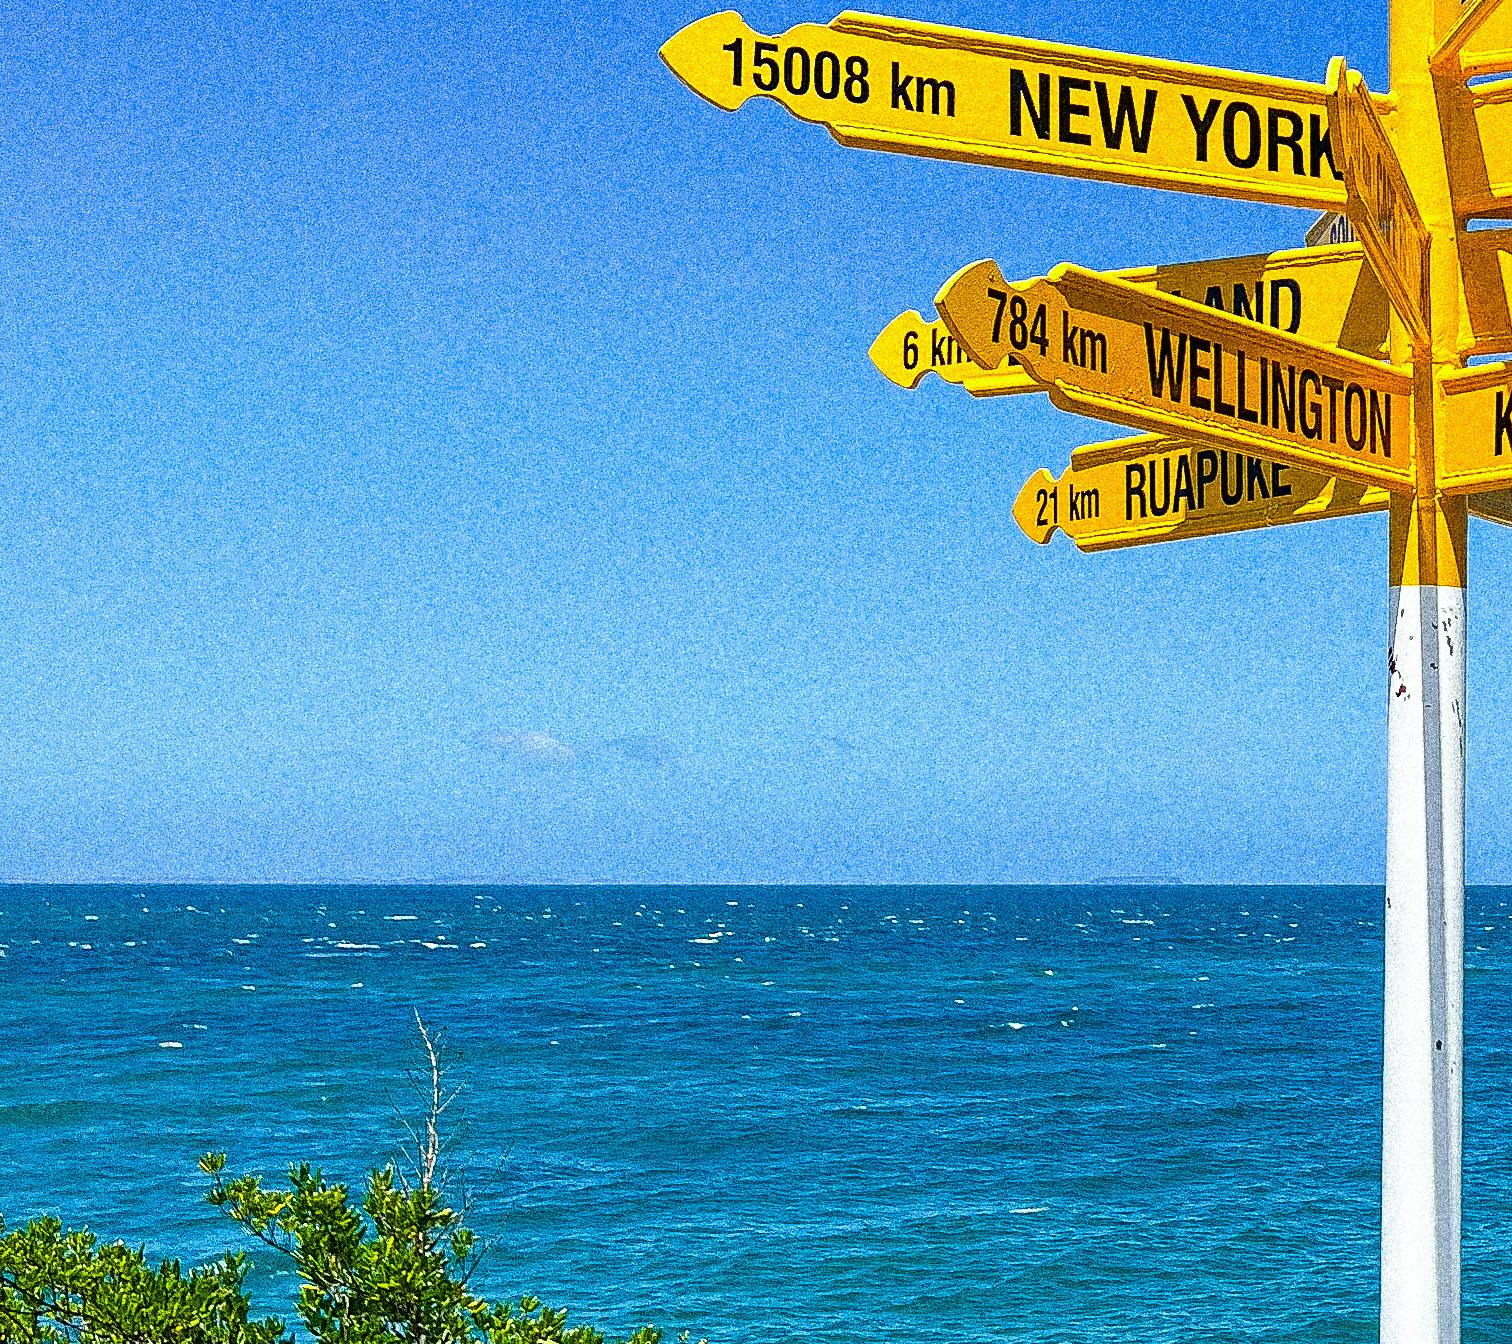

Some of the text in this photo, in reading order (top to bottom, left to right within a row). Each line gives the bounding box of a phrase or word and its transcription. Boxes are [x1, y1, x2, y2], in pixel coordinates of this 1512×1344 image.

[722, 37, 1345, 181] 15008 km NEW YORK
[903, 330, 920, 370] 6
[987, 288, 1393, 459] 784 km WELLINGTON
[1035, 450, 1292, 526] 21 km RUAPUKE
